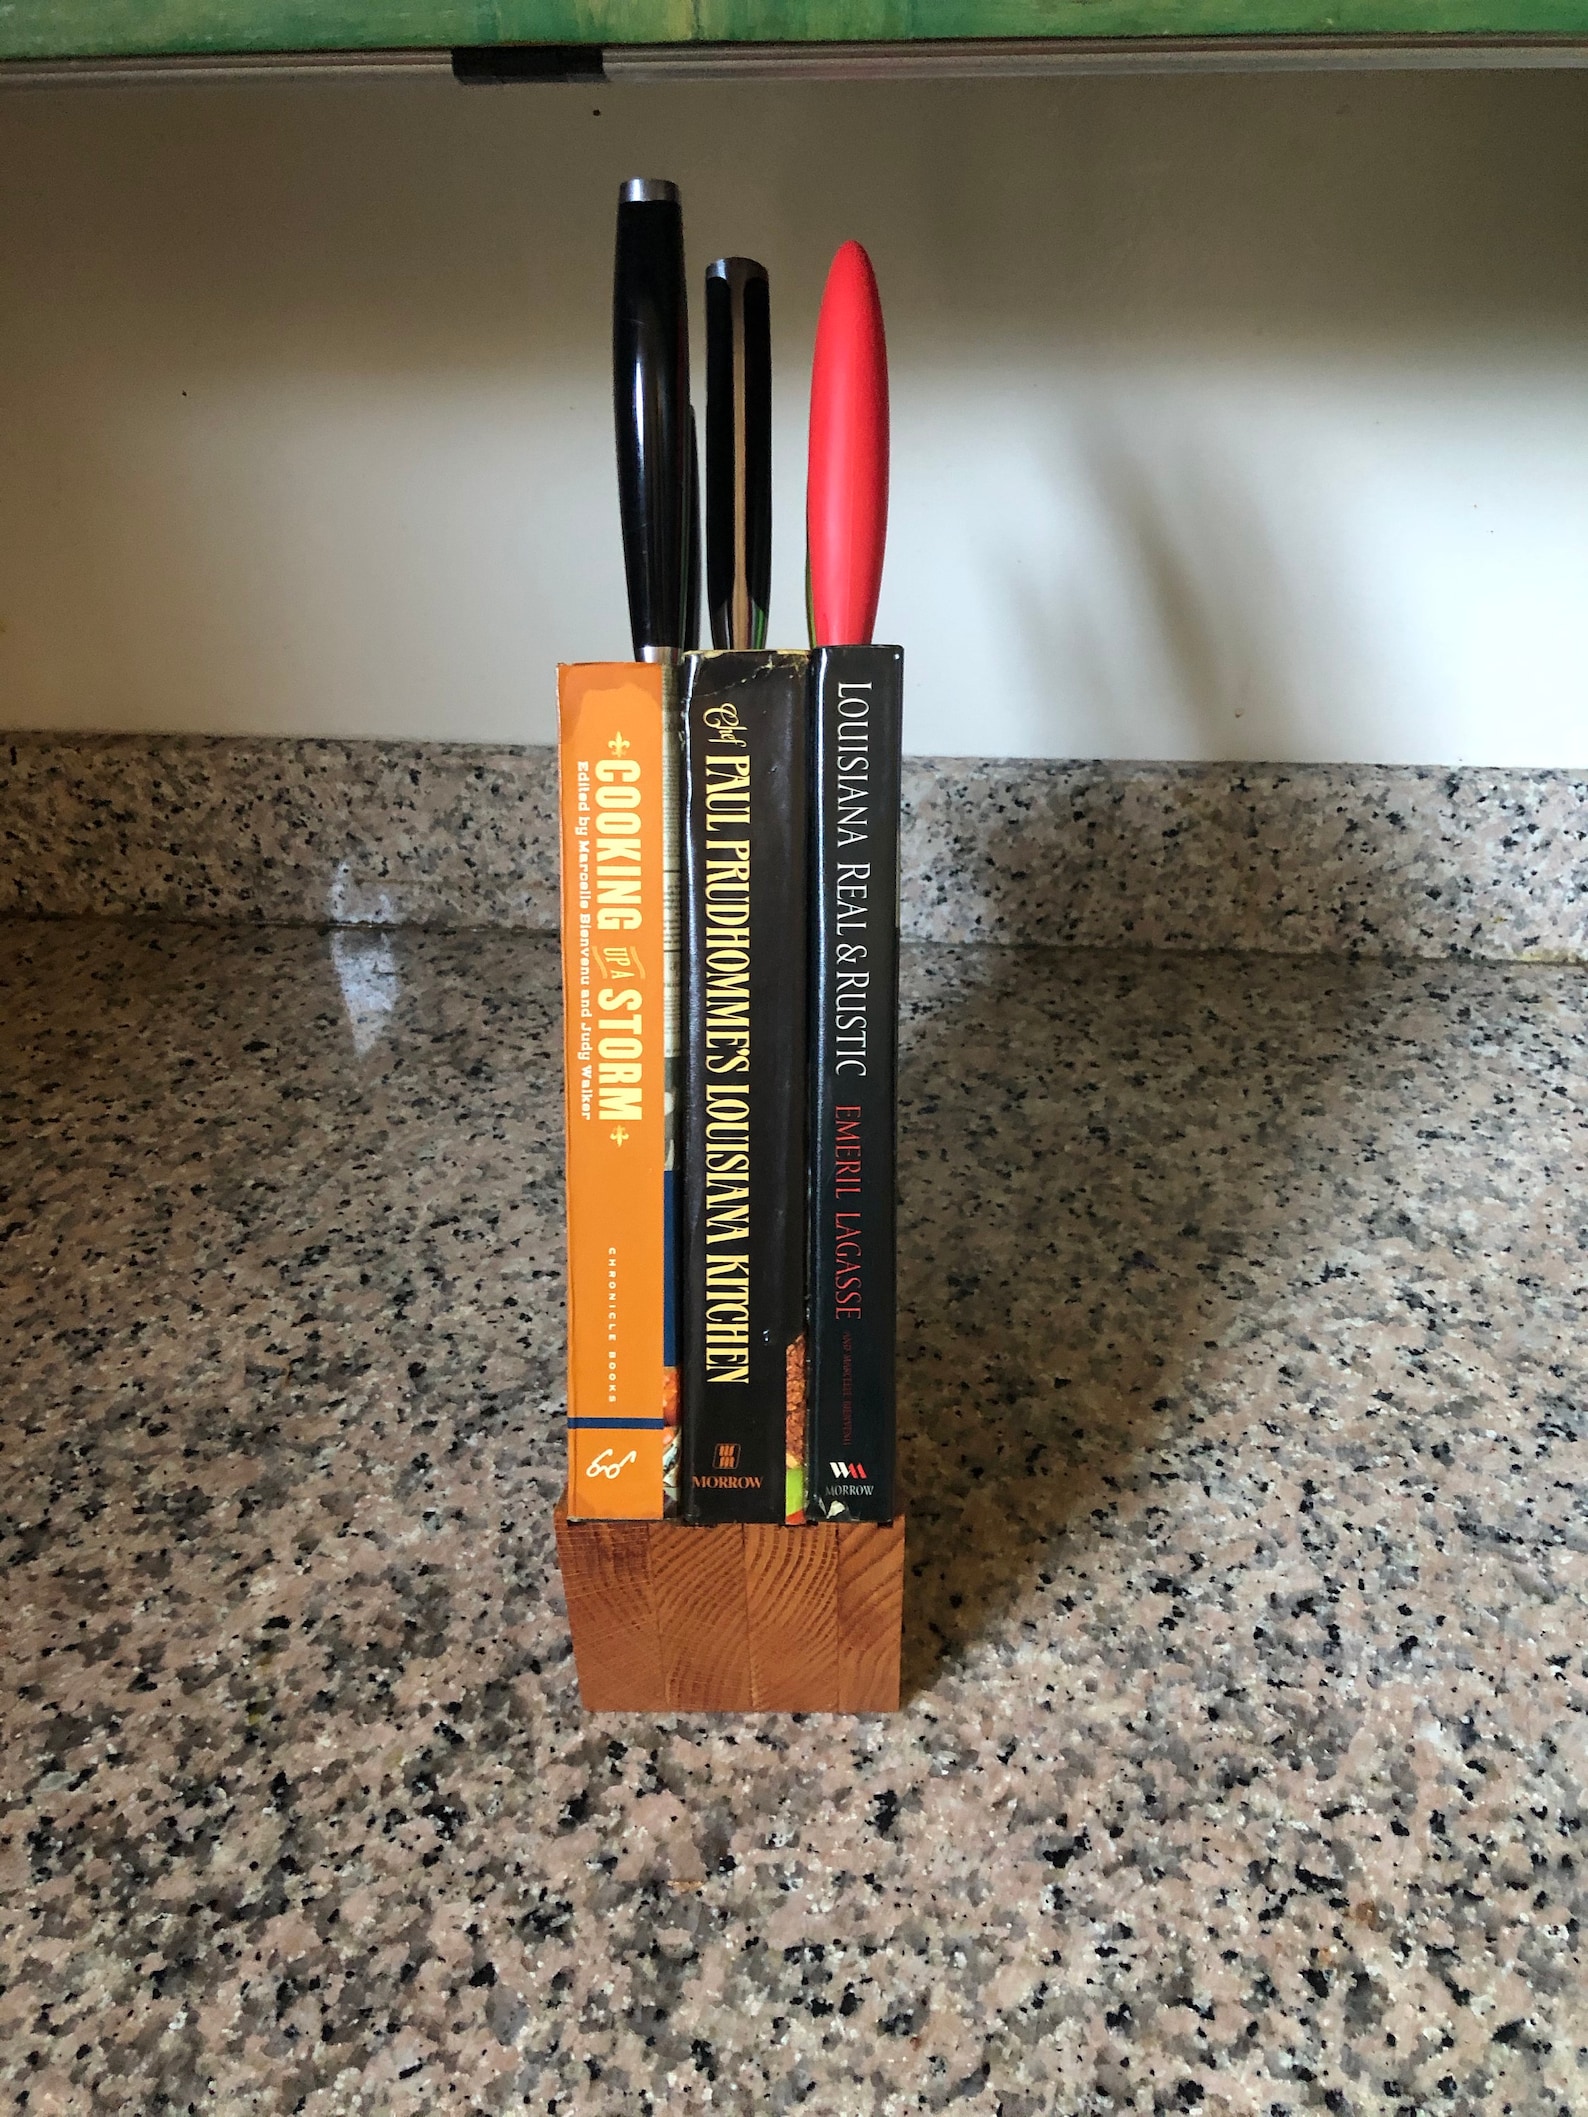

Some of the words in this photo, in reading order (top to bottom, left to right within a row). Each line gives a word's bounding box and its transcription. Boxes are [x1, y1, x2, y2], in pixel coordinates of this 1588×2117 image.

[702, 702, 747, 748] Chef
[576, 760, 590, 811] Edited
[705, 755, 752, 832] PAUL
[837, 682, 873, 848] LOUISIANA
[575, 816, 591, 836] by
[594, 758, 643, 930] COOKING
[578, 840, 592, 908] Marcelle
[836, 862, 871, 937] REAL
[579, 913, 592, 985] Bienvenu
[603, 947, 631, 966] UP
[610, 970, 635, 979] A
[705, 839, 752, 1074] PRUDHOMME'S
[836, 943, 868, 965] &
[580, 990, 592, 1017] and
[835, 971, 870, 1077] RUSTIC
[577, 1022, 593, 1060] Judy
[597, 988, 643, 1121] STORM
[580, 1065, 594, 1120] Walker
[705, 1084, 751, 1245] LOUISIANA
[835, 1105, 862, 1199] EMERIL
[608, 1247, 617, 1341] CHRONICLE
[835, 1212, 862, 1320] LAGASSE
[705, 1253, 751, 1384] KITCHEN
[608, 1351, 617, 1403] BOOKS
[692, 1475, 764, 1489] MORROW
[825, 1484, 874, 1497] MORROW
